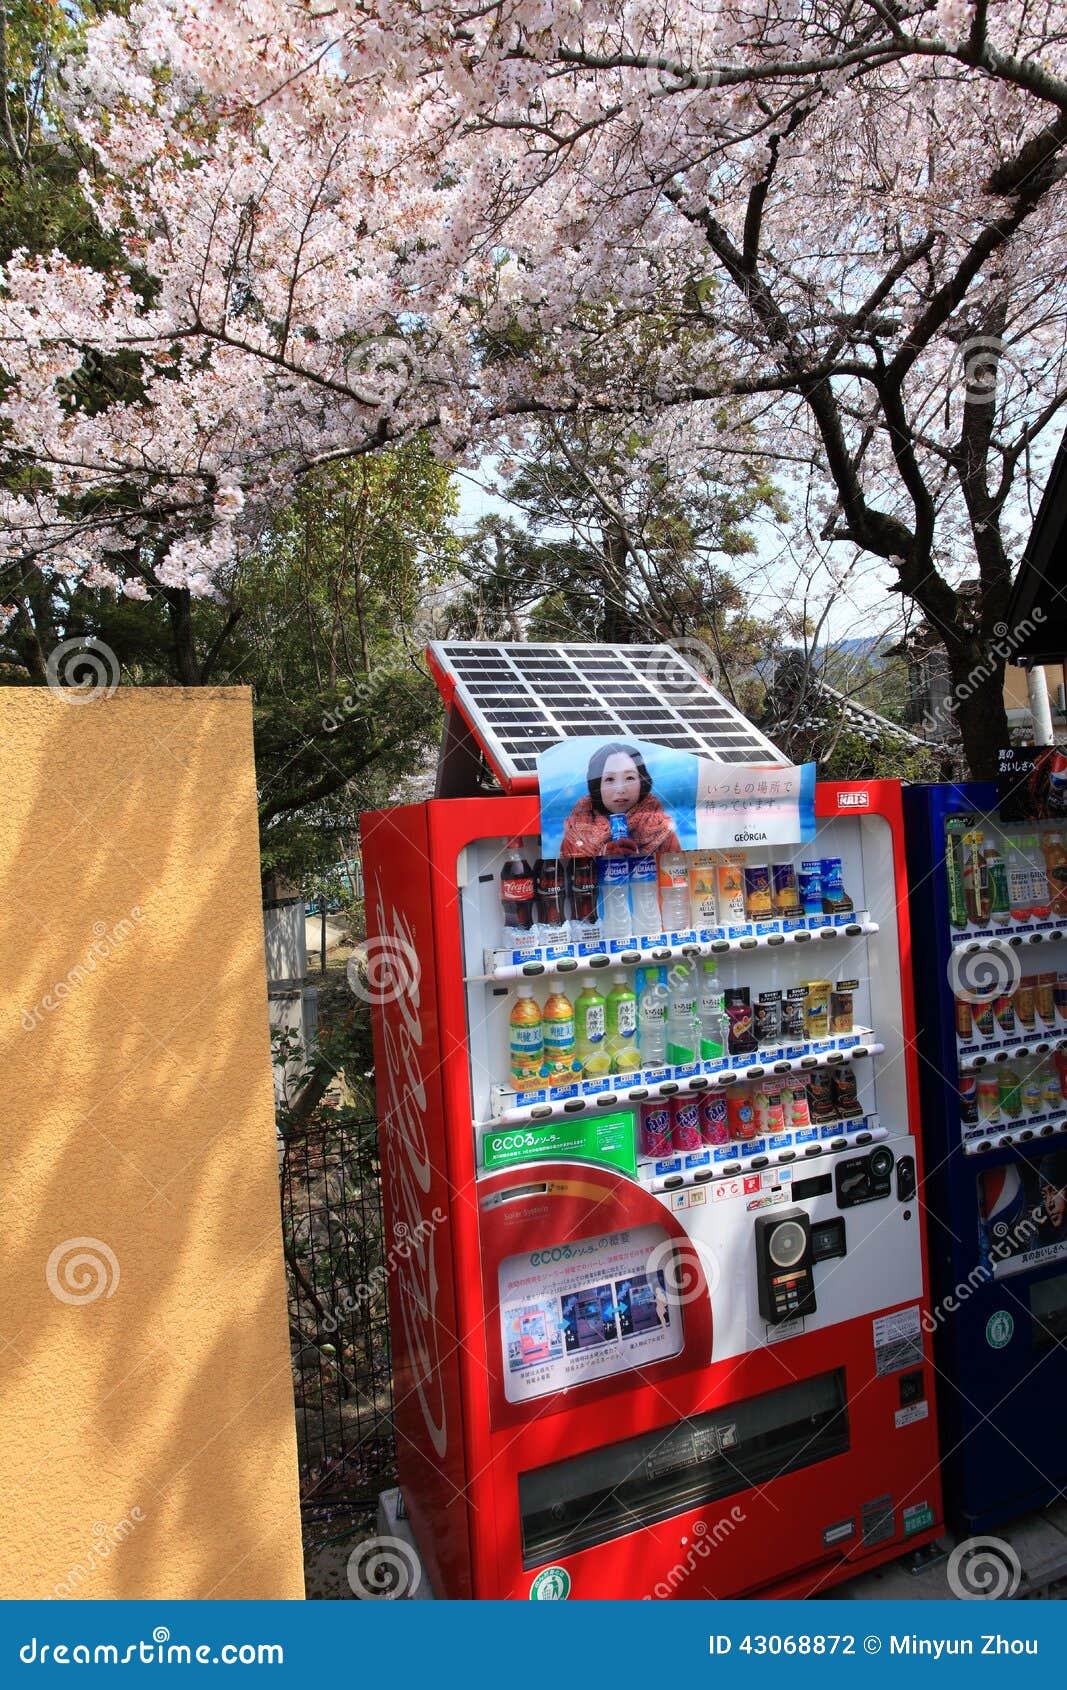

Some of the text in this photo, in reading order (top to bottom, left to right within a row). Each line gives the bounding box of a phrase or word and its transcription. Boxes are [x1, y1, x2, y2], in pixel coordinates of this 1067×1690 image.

[998, 749, 1014, 760] 真の
[999, 761, 1036, 772] おいしさへ
[707, 781, 793, 795] いつもの場所で
[734, 832, 767, 842] GEORGIA
[374, 872, 447, 1458] Coca-Cola
